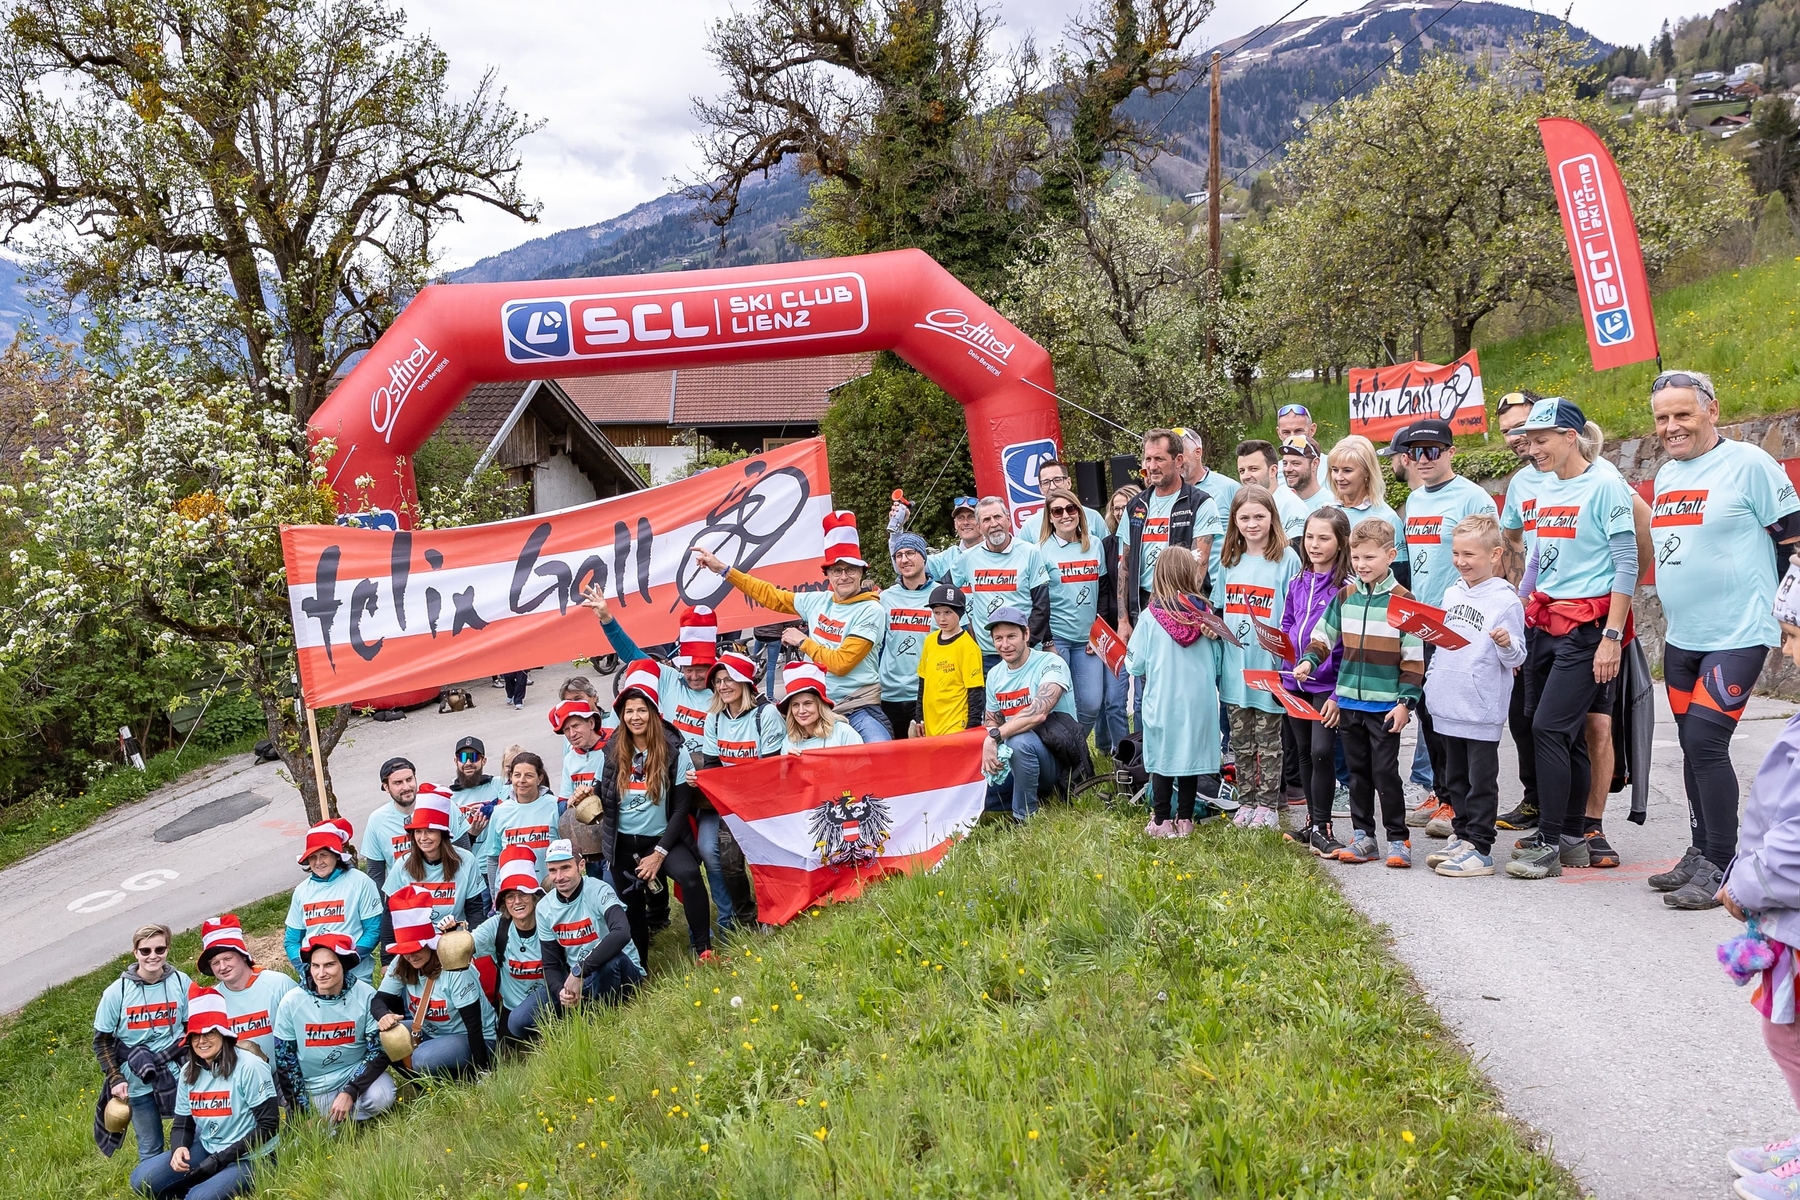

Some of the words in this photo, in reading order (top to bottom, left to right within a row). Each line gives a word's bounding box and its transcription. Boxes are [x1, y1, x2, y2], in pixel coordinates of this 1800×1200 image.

[730, 293, 773, 313] SKI
[781, 285, 853, 310] CLUB
[582, 301, 709, 345] SCL
[731, 310, 811, 334] LIENZ
[509, 517, 653, 616] Gall
